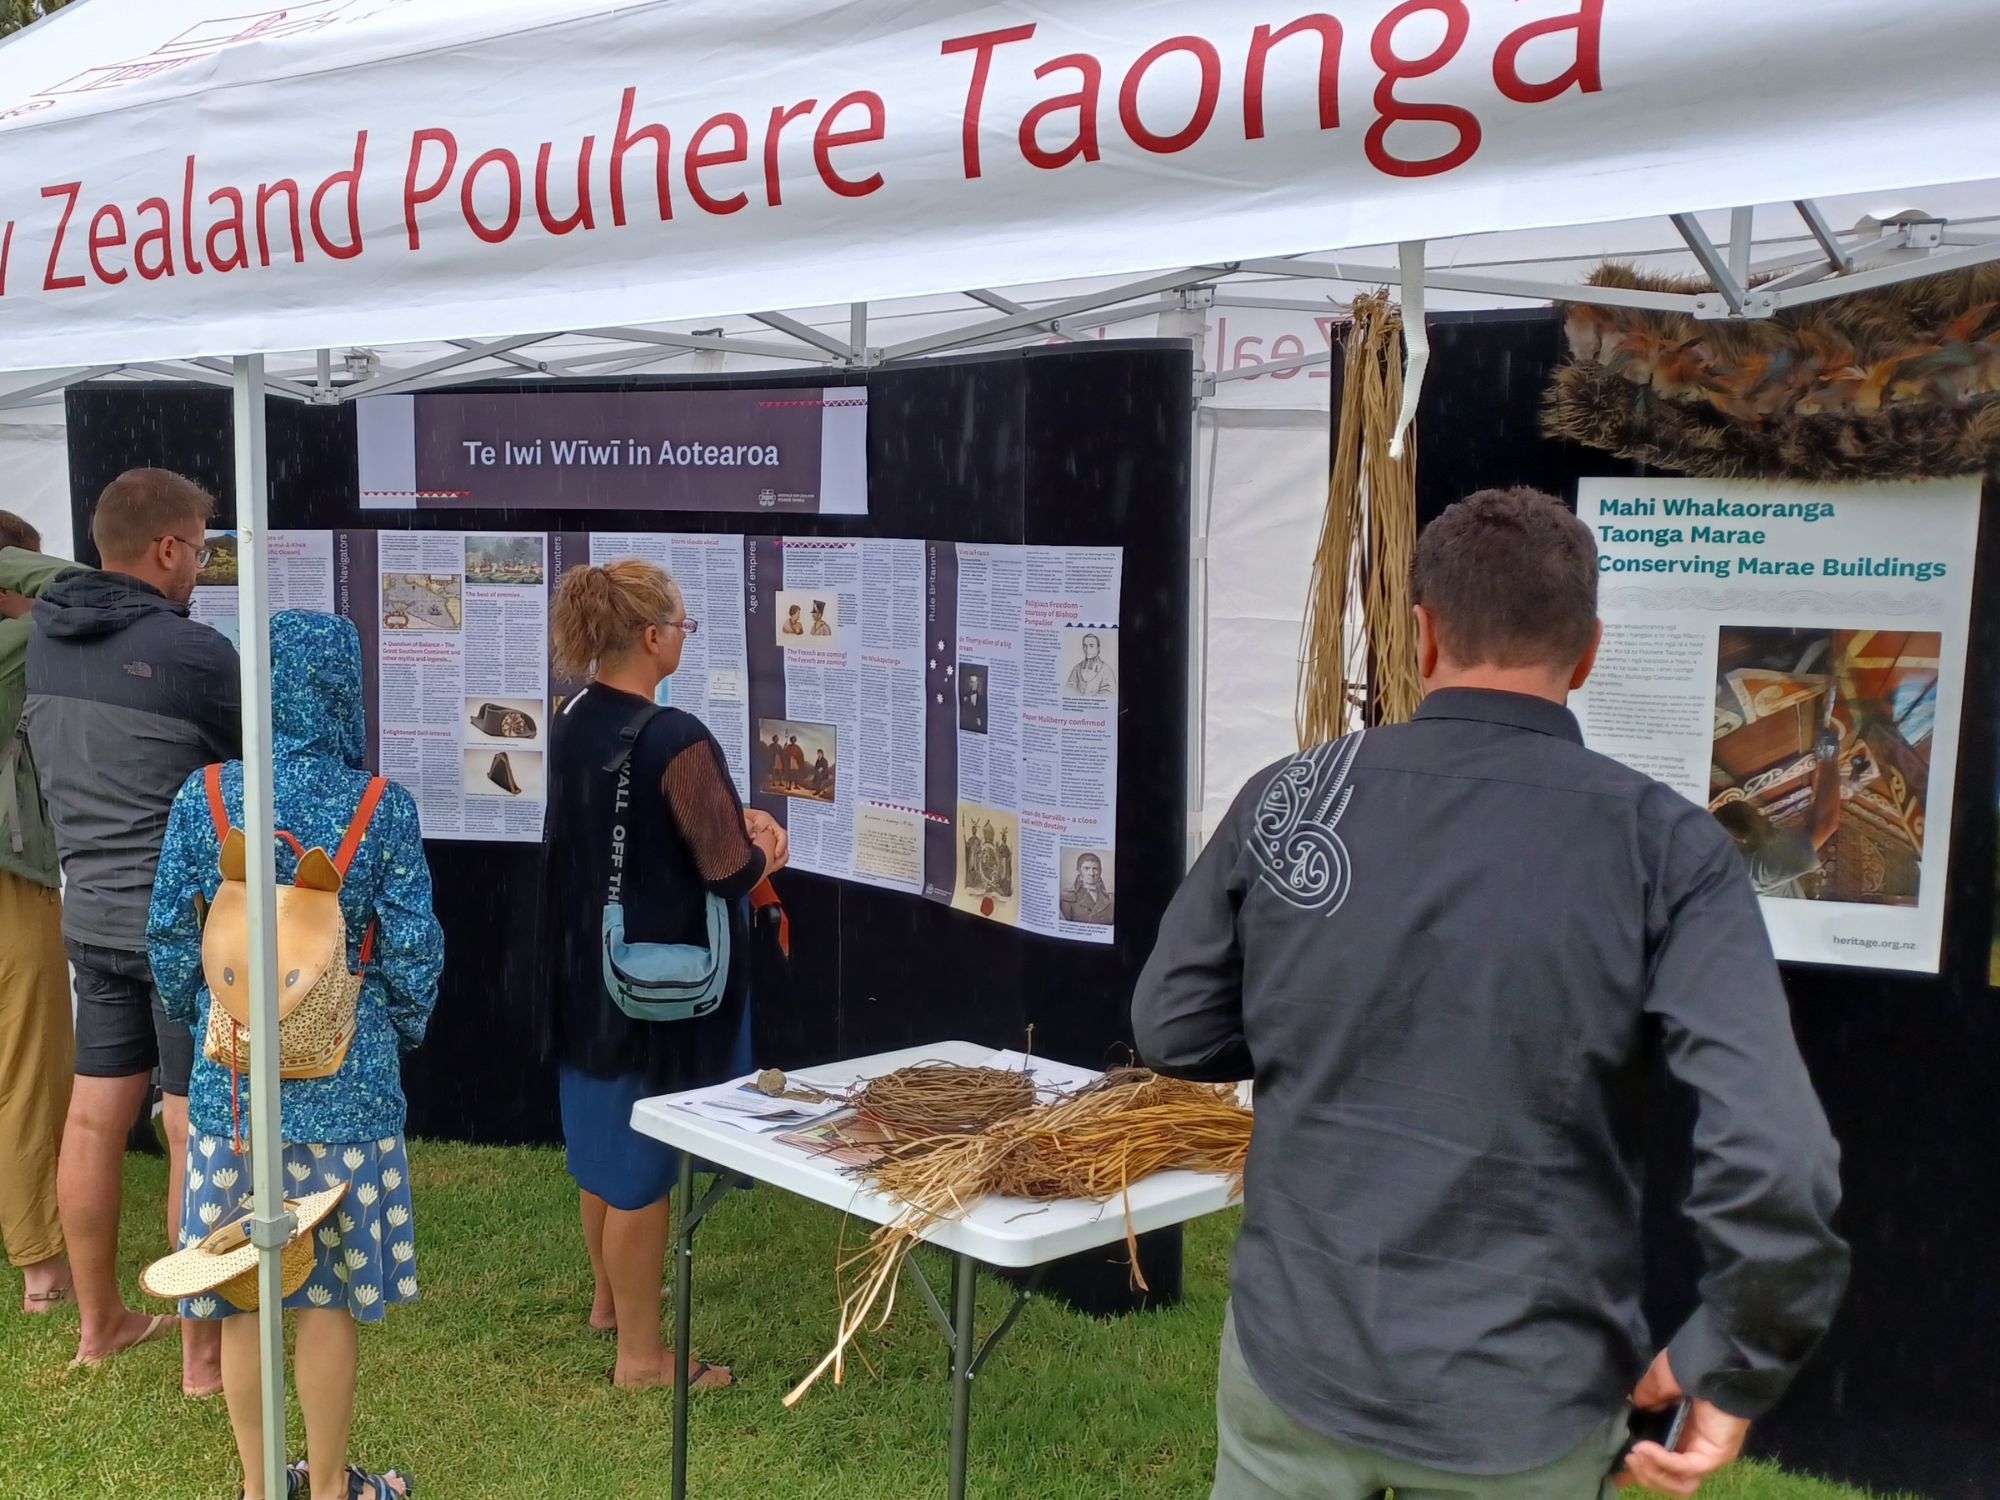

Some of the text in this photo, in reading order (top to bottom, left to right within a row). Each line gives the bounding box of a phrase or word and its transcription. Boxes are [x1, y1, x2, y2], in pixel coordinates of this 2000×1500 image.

[40, 129, 368, 290] Zealand
[409, 86, 885, 250] Pouhere
[940, 0, 1602, 178] Taonga
[462, 439, 780, 466] Te Iwi Wīwī in Aotearoa
[1599, 498, 1835, 522] Mahi Whakaoranga
[1597, 526, 1766, 547] Taonga Marae
[339, 534, 350, 583] Navigators
[553, 536, 561, 590] Encounters
[928, 546, 937, 595] Britannia
[1598, 555, 1947, 582] Conserving Marae Buildings
[748, 540, 759, 613] Age of empires
[1050, 601, 1078, 609] Freedom
[1055, 611, 1078, 619] Bishop
[1068, 719, 1106, 727] confirmed
[1043, 821, 1067, 832] destiny
[611, 824, 626, 869] OFF
[608, 872, 622, 906] TH
[1833, 935, 1916, 951] heritage.org.nz
